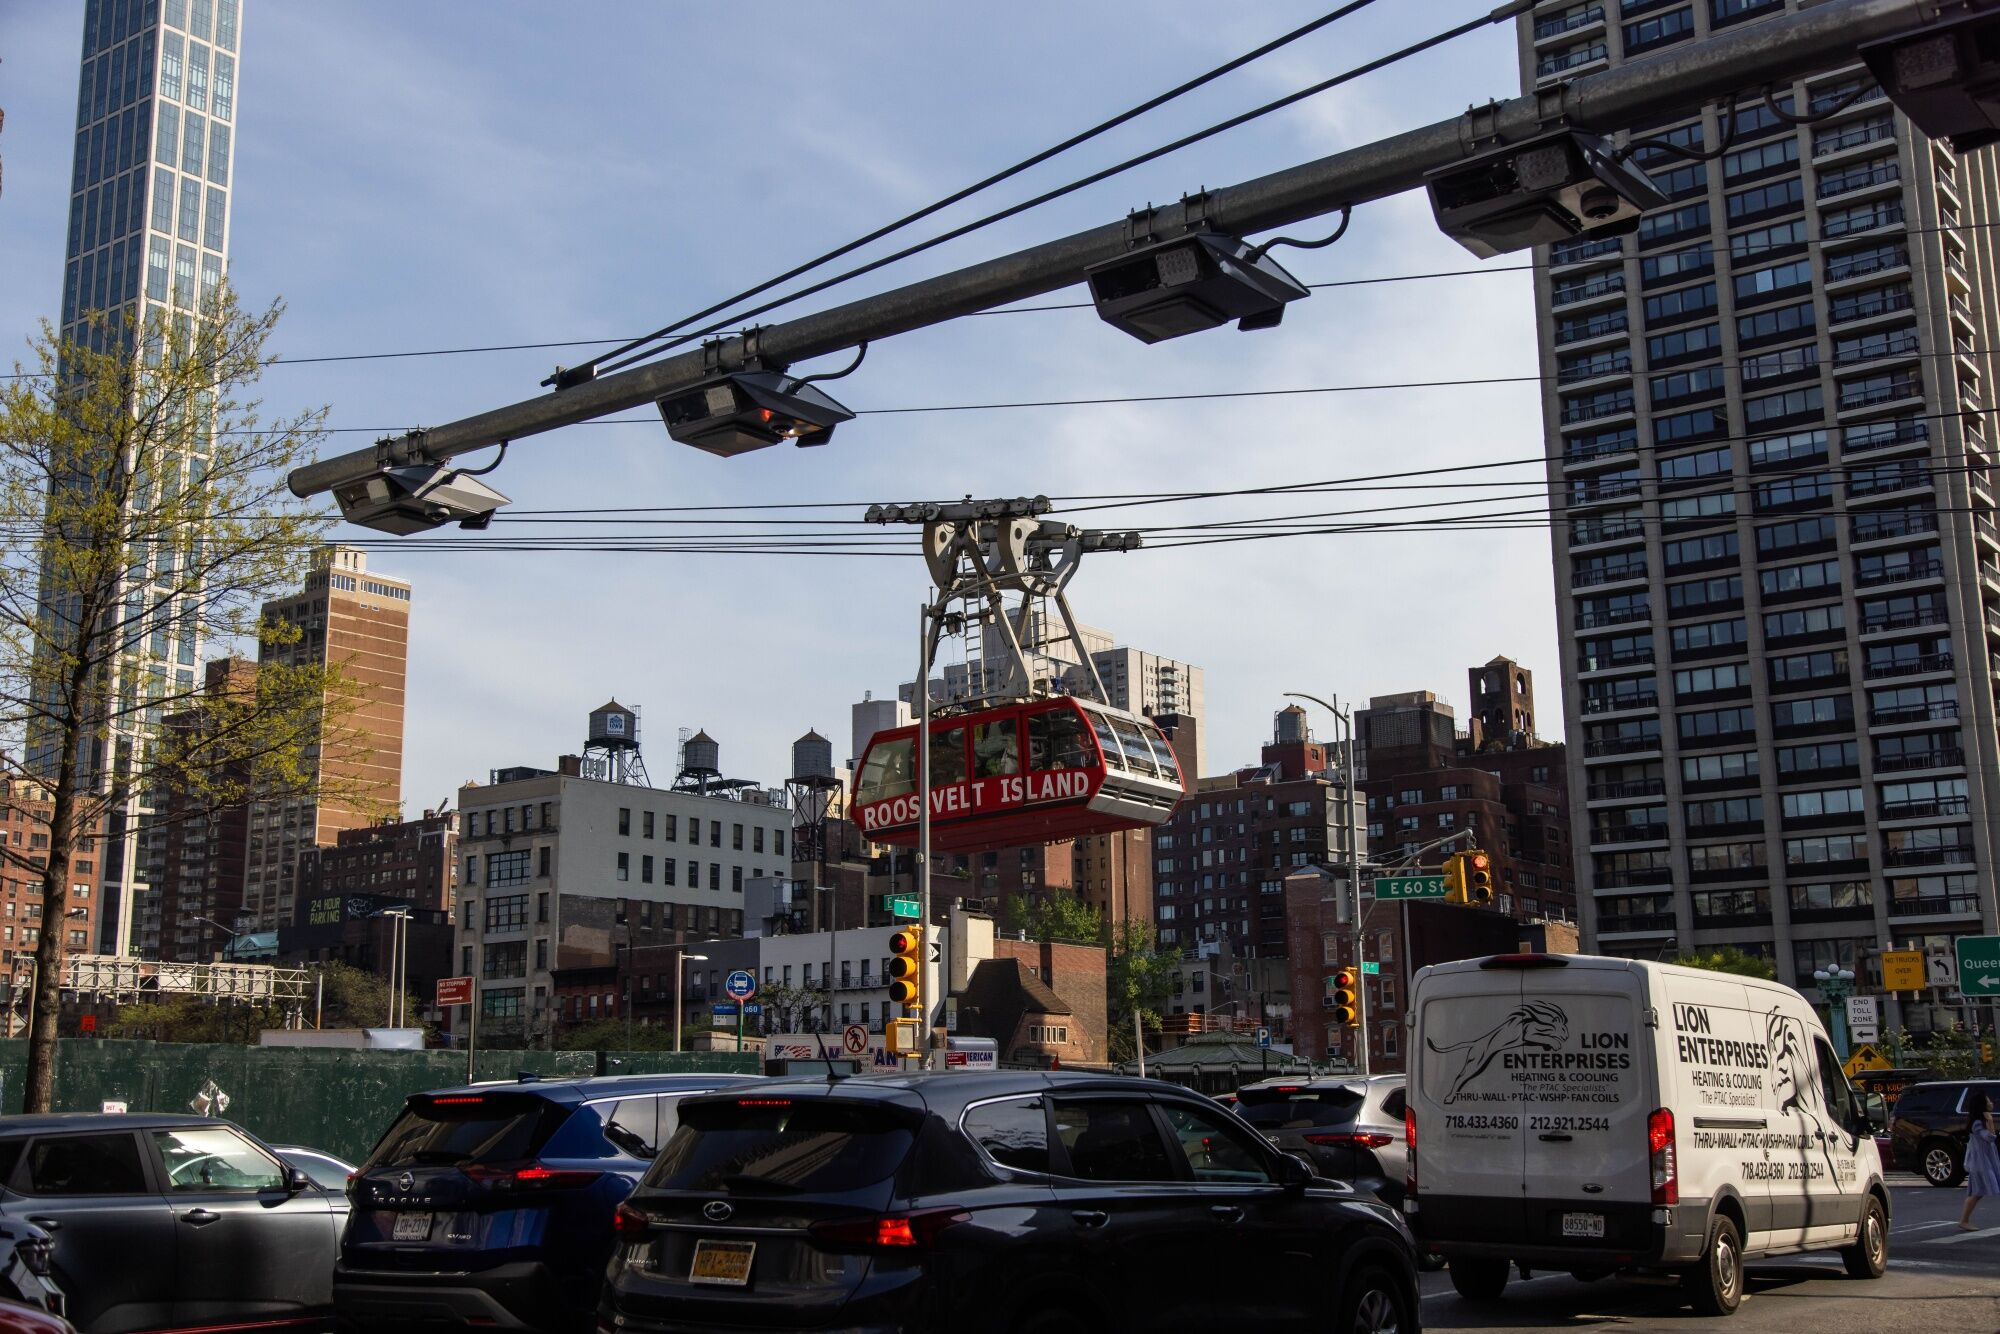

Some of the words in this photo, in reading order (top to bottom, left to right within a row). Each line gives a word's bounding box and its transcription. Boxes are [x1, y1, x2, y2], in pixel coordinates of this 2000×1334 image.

[864, 783, 985, 830] ROOSVELT
[1001, 772, 1089, 803] ISLAND
[1391, 882, 1399, 895] E
[1403, 881, 1423, 894] 60
[1428, 880, 1445, 893] St
[310, 900, 322, 913] 24
[323, 897, 341, 910] HOUR
[903, 903, 908, 915] 2
[310, 910, 340, 925] PARKING
[1365, 963, 1370, 972] 2
[1964, 959, 2000, 969] Quee
[1672, 1003, 1711, 1035] LION
[1259, 1029, 1269, 1043] P
[1581, 1033, 1629, 1049] LION
[1677, 1035, 1769, 1070] ENTERPRISES
[1503, 1053, 1631, 1070] ENTERPRISES
[1511, 1072, 1556, 1083] HEATING
[1558, 1072, 1567, 1082] &
[1569, 1072, 1619, 1083] COOLING
[1692, 1070, 1725, 1088] HEATING
[1726, 1074, 1731, 1087] &
[1732, 1073, 1762, 1090] COOLING
[1539, 1083, 1559, 1092] PTAC
[1455, 1093, 1506, 1102] THRU-WALL
[1512, 1093, 1535, 1102] PTAC
[1539, 1093, 1567, 1102] WSHP
[1572, 1094, 1590, 1103] FAN
[1592, 1094, 1620, 1103] COILS
[1713, 1091, 1728, 1105] PTAC
[1445, 1115, 1519, 1130] 718.433.4360
[1530, 1116, 1610, 1131] 212.921.2544
[1693, 1132, 1737, 1148] THRU-WALL
[1741, 1133, 1759, 1149] PTAC
[1762, 1133, 1782, 1149] WSHP
[1784, 1134, 1797, 1149] FAN
[1797, 1134, 1815, 1150] COILS
[1741, 1162, 1785, 1180] 718.433.4360
[1788, 1162, 1824, 1180] 212.921.2544
